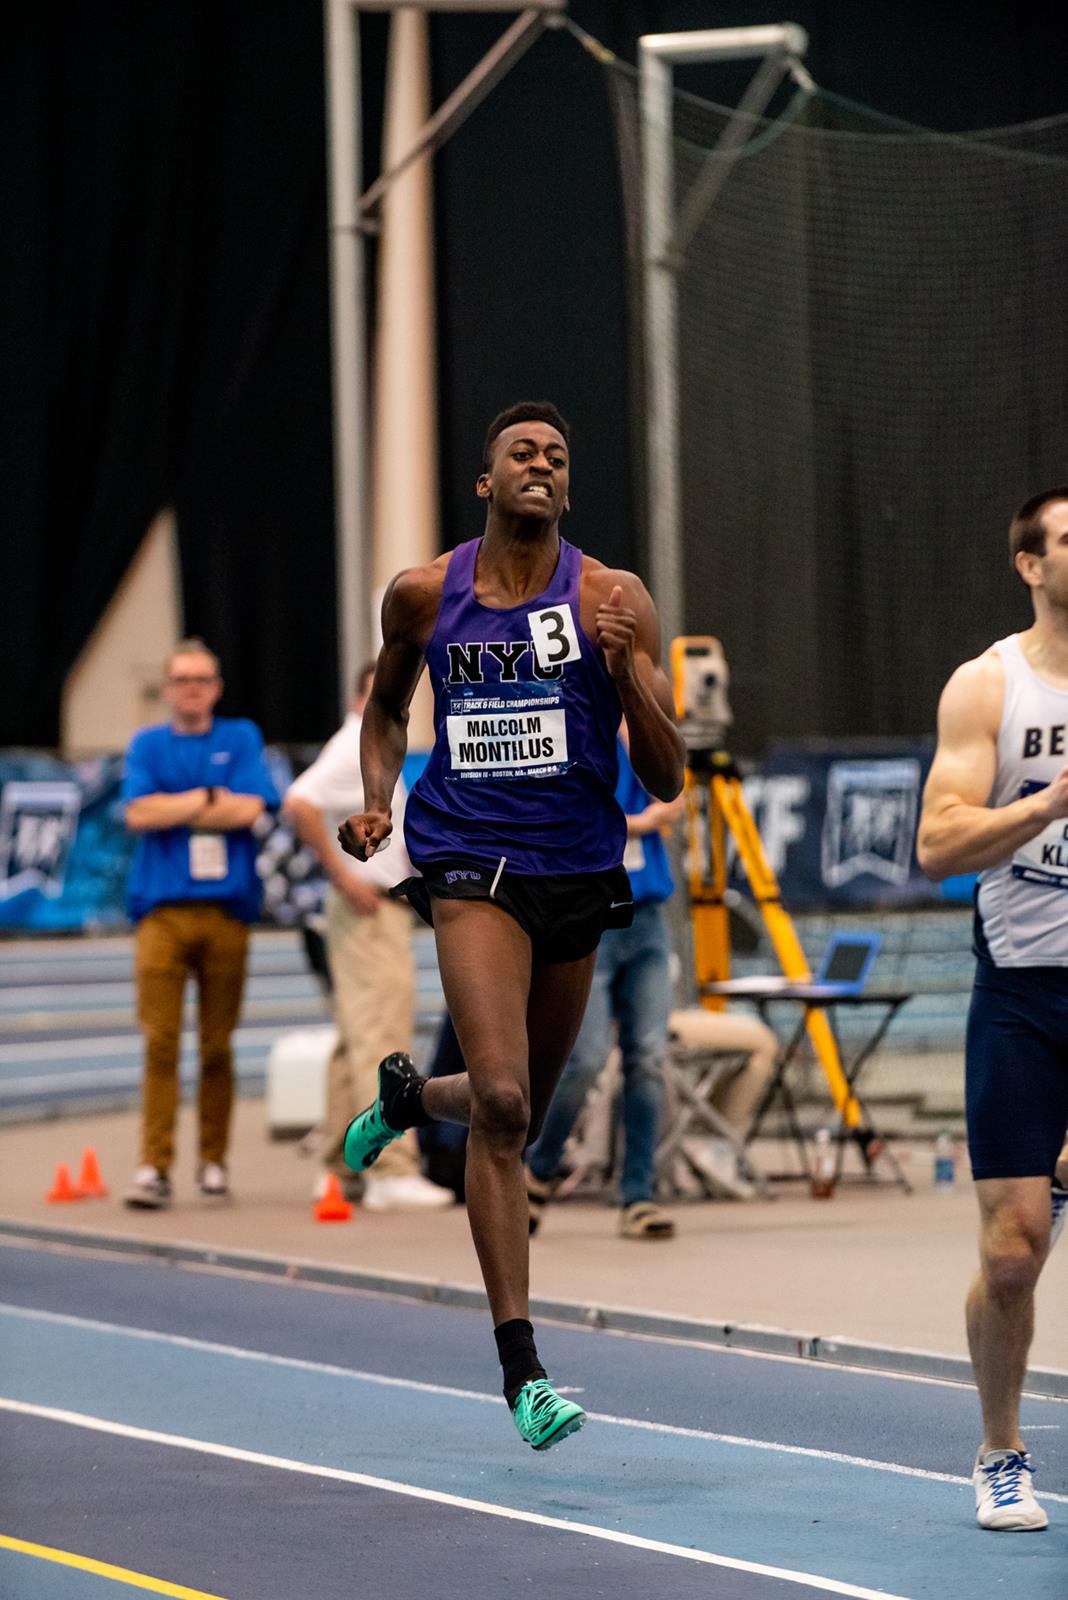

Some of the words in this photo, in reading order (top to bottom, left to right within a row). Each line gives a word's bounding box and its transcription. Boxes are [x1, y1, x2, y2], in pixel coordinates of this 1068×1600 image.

[540, 611, 570, 662] 3
[463, 701, 482, 709] TRACK
[488, 700, 505, 709] FIELD
[506, 696, 560, 708] CHAMPIONSHIPS
[467, 716, 541, 737] MALCOLM
[459, 736, 554, 763] MONTILUS
[460, 771, 482, 779] DIVISION
[527, 766, 547, 775] MARCH
[1041, 843, 1068, 868] KL
[445, 870, 481, 884] NYU
